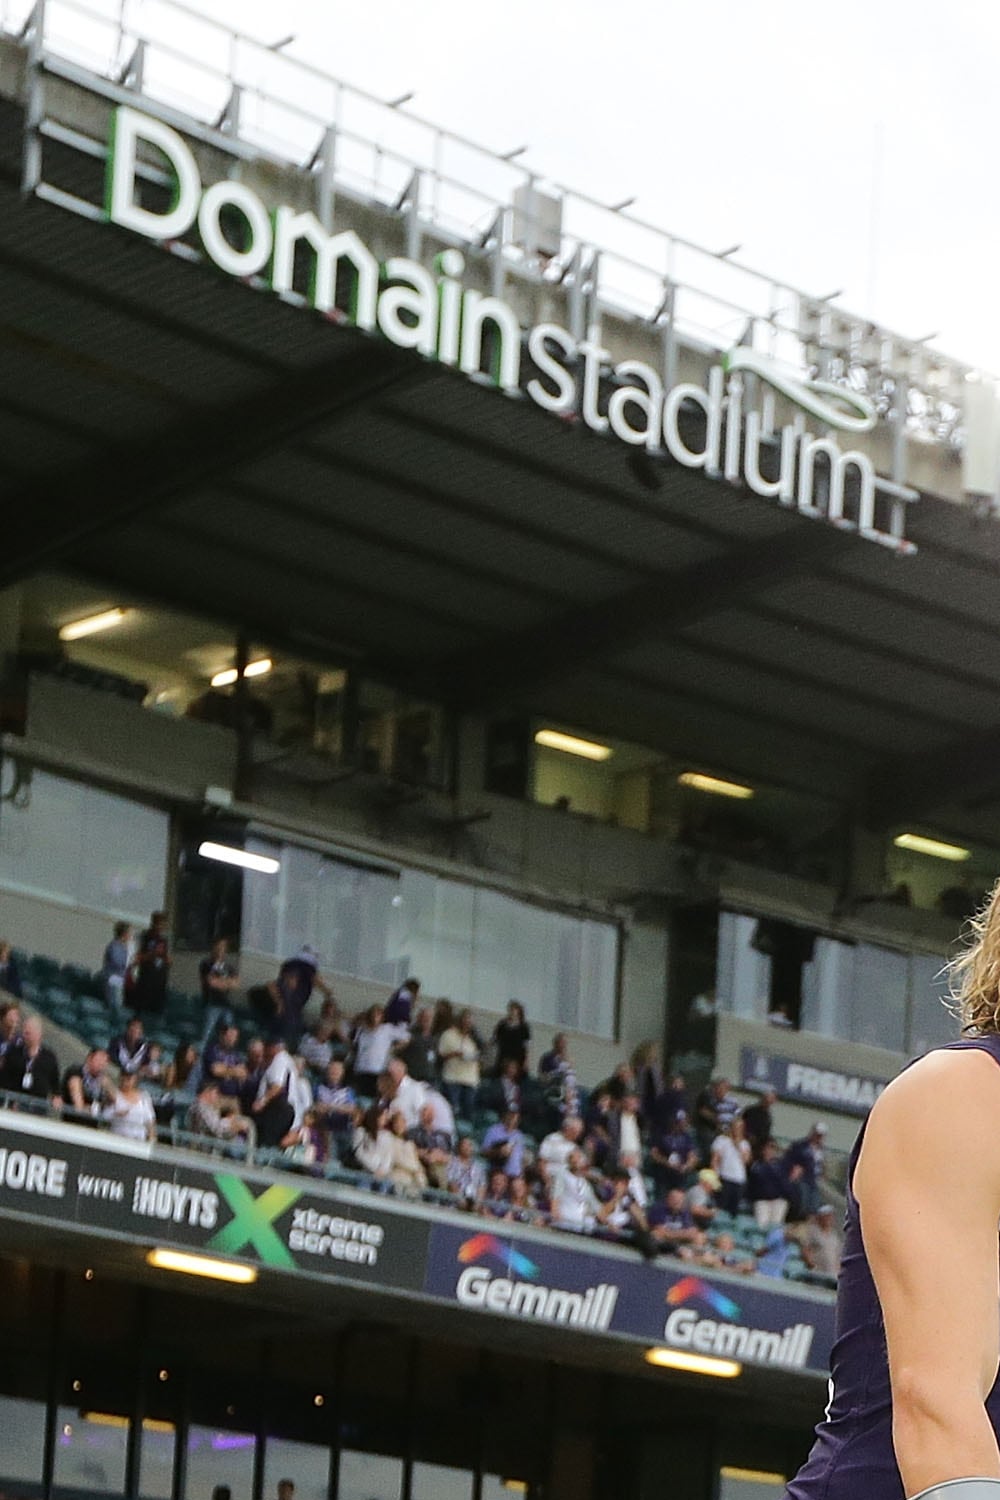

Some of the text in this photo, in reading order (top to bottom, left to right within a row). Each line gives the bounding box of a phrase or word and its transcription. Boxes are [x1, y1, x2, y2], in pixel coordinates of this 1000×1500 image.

[0, 1147, 68, 1197] ORE
[77, 1173, 125, 1201] WITH
[138, 1176, 220, 1230] HOYTS
[288, 1229, 379, 1266] screen
[293, 1207, 385, 1248] xtreme
[456, 1266, 620, 1331] Gemmill
[664, 1308, 815, 1370] Gemmill
